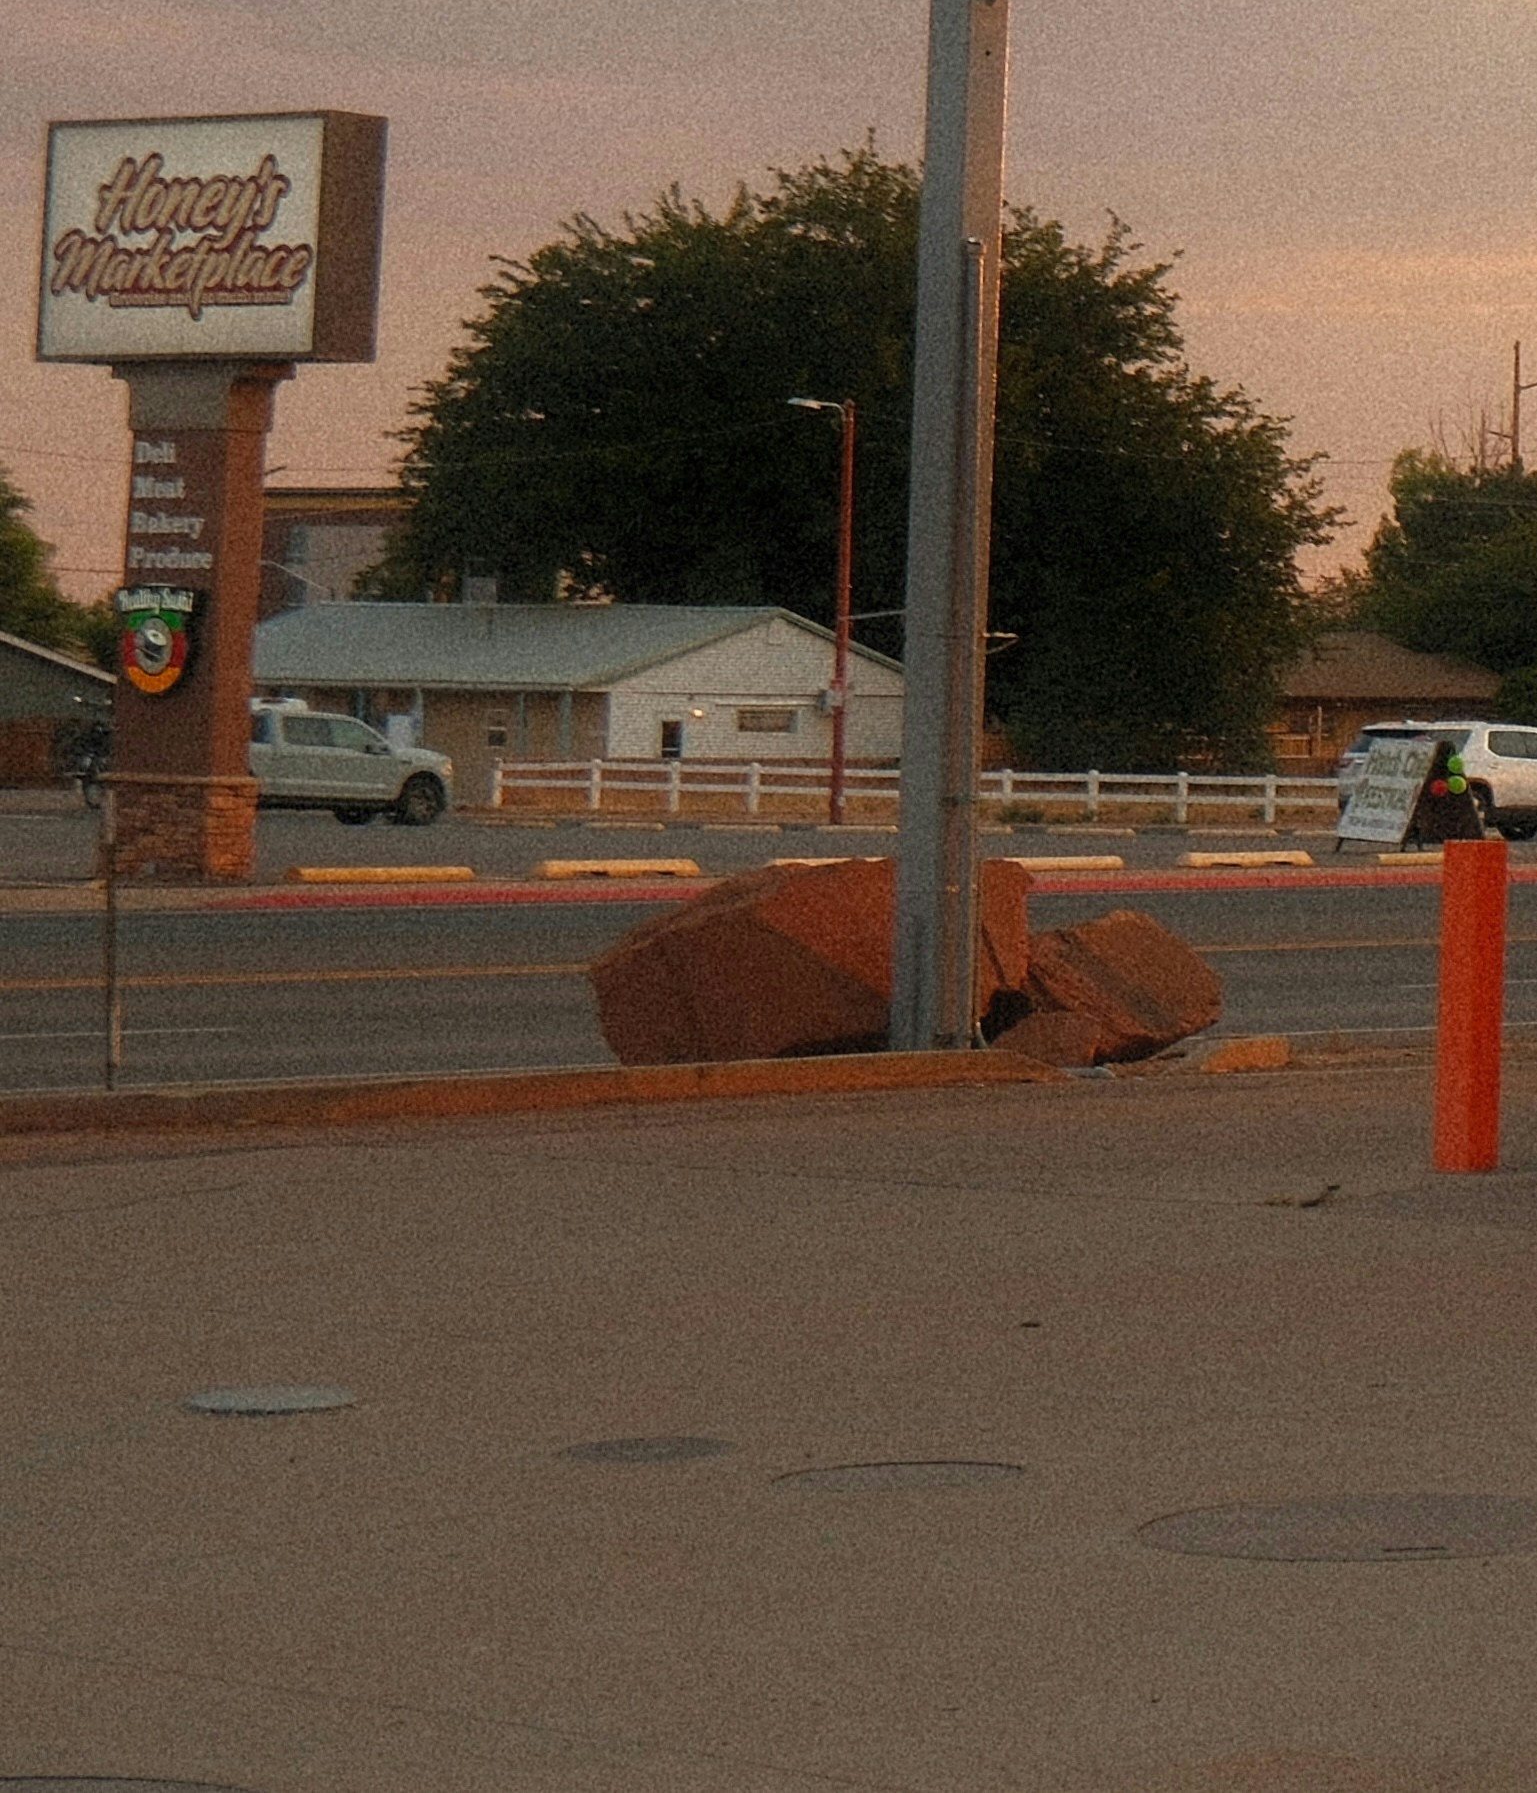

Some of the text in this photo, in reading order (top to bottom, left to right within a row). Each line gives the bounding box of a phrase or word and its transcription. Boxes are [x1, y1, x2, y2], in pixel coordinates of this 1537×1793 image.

[95, 152, 291, 248] Honey's
[51, 228, 313, 321] Marketplace
[129, 511, 205, 540] Bakery
[127, 546, 214, 569] Produce
